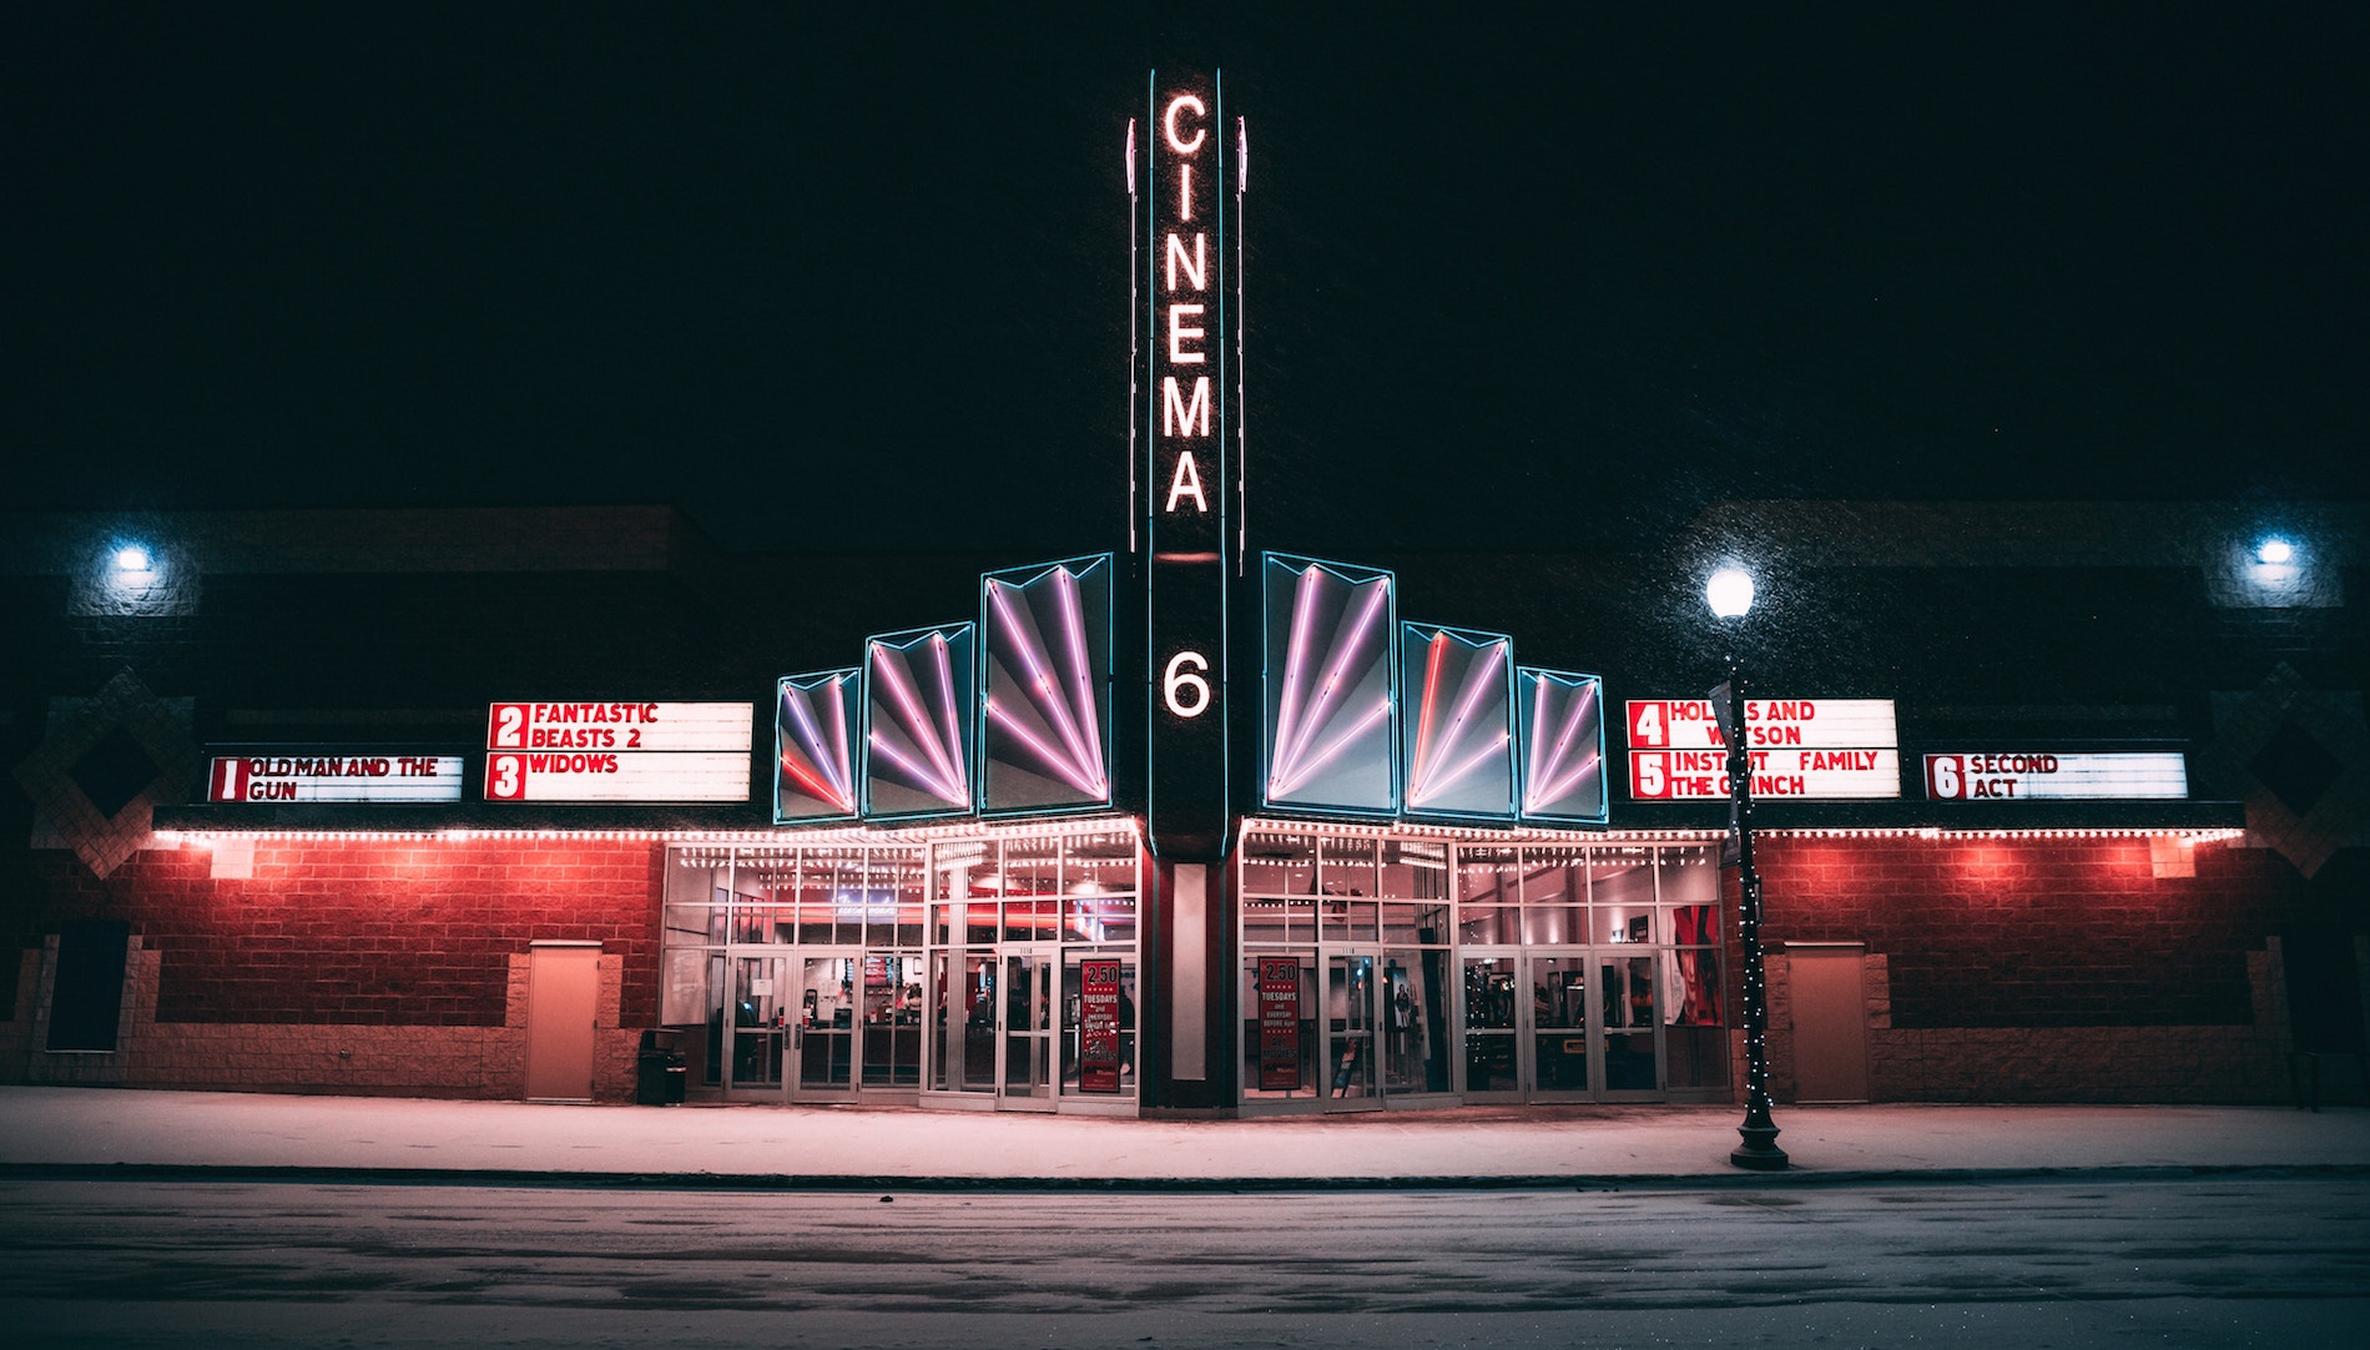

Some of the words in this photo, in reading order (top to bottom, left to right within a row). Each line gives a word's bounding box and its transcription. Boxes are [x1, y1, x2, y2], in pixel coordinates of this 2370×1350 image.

[1163, 95, 1210, 513] CINEMA
[1163, 651, 1211, 718] 6
[534, 703, 658, 723] FANTASTIC
[1671, 702, 1760, 720] HOLS
[1767, 702, 1815, 720] AND
[497, 706, 523, 747] 2
[1636, 704, 1663, 745] 4
[531, 728, 615, 748] BEASTS
[626, 728, 641, 748] 2
[1706, 726, 1801, 745] WSON
[249, 758, 291, 777] OLD
[294, 758, 342, 777] MAN
[346, 758, 390, 777] AND
[398, 758, 438, 777] THE
[529, 754, 618, 773] WIDOWS
[1675, 752, 1769, 771] INSTT
[1799, 751, 1878, 771] FAMILY
[1971, 754, 2058, 774] SECOND
[222, 760, 239, 799] 1
[494, 756, 520, 798] 3
[1639, 753, 1665, 797] 5
[1934, 757, 1960, 798] 6
[250, 782, 297, 800] GUN
[1671, 777, 1714, 795] THE
[1719, 776, 1805, 795] GINCH
[1974, 779, 2018, 797] ACT
[1088, 966, 1117, 983] 2.50
[1266, 964, 1296, 980] 2.50
[1084, 994, 1117, 1004] TUESDAYS
[1262, 991, 1297, 1001] TUESDAYS
